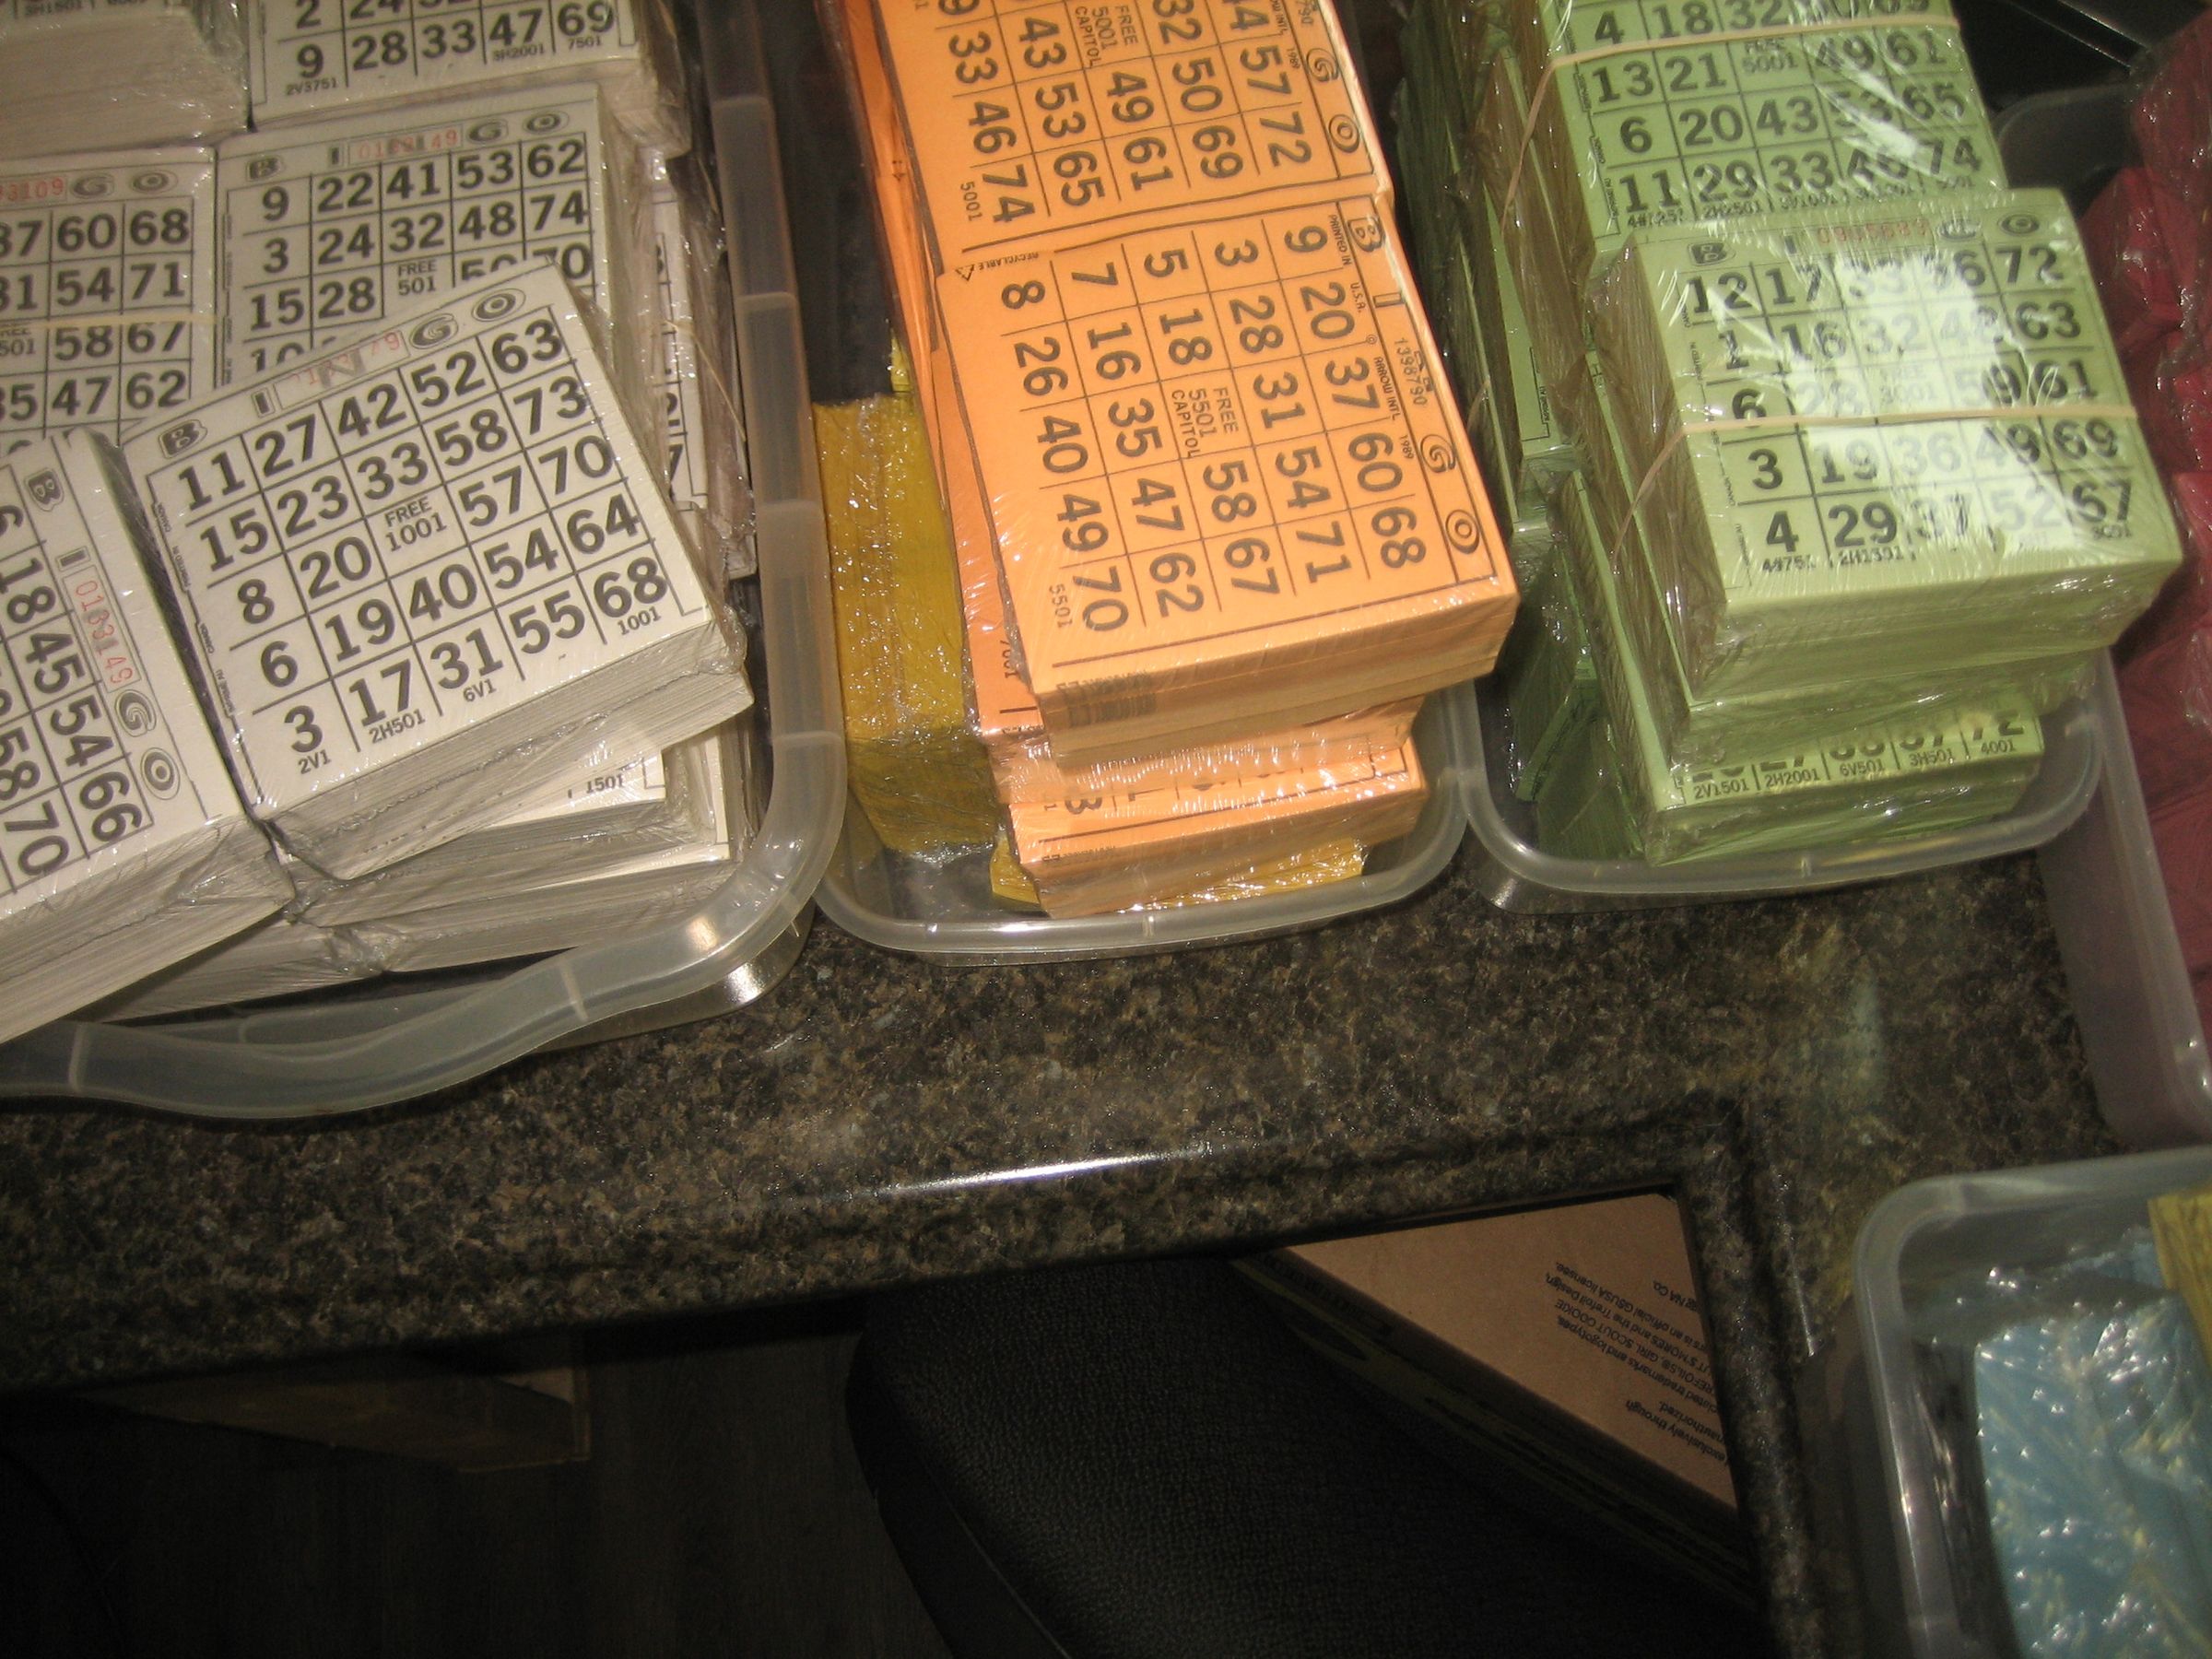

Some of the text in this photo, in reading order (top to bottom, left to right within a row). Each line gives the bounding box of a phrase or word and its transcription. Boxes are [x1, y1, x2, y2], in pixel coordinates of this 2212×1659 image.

[351, 8, 544, 71] 28 33 47
[568, 35, 601, 50] 7501
[1074, 6, 1102, 69] CAPITOL
[1092, 6, 1117, 51] 5001
[1115, 5, 1138, 46] FREE
[1287, 47, 1300, 70] 1989
[1593, 60, 1653, 104] 13
[1665, 53, 1726, 93] 21
[947, 31, 1036, 223] 33 46 74
[1018, 17, 1105, 206] 43 53 65
[1107, 71, 1174, 192] 49 61
[1171, 56, 1243, 179] 50 69
[1240, 44, 1312, 167] 57 72
[1679, 95, 1819, 147] 20 43
[262, 139, 585, 221] 9 22 41 53 62
[960, 182, 982, 221] 5001
[1619, 169, 1680, 213] 11
[1693, 159, 1758, 204] 29
[1769, 151, 1835, 194] 33
[56, 208, 190, 253] 60 68
[264, 190, 588, 273] 3 24 32 48 74
[56, 262, 185, 306] 54 71
[397, 260, 438, 275] FREE
[978, 252, 1040, 270] RECYCLABLE
[250, 277, 376, 331] 15 28
[397, 280, 437, 296] 501
[1688, 271, 1748, 314] 12
[1328, 214, 1347, 253] PRINTED
[1349, 282, 1362, 312] U.S.A.
[1373, 357, 1394, 395] ARROW
[1401, 435, 1414, 460] 1989
[2016, 301, 2082, 342] 63
[52, 370, 186, 415] 47 62
[1014, 336, 1068, 396] 26
[178, 452, 245, 511] 11
[254, 414, 316, 477] 27
[338, 383, 406, 437] 42
[411, 352, 486, 407] 52
[492, 320, 563, 373] 63
[1171, 390, 1201, 459] CAPITOL
[1189, 389, 1218, 439] 5501
[1214, 387, 1239, 434] FREE
[1300, 281, 1427, 569] 20 37 60 68
[1037, 415, 1088, 474] 40
[1159, 308, 1280, 594] 18 58 67
[1230, 295, 1352, 583] 28 31 54 71
[1747, 418, 2119, 490] 3 69
[200, 376, 588, 571] 15 23 33 58 73
[1087, 322, 1204, 618] 16 35 47 62
[238, 579, 275, 624] 8
[300, 537, 372, 599] 20
[458, 465, 522, 526] 57
[538, 435, 613, 494] 70
[384, 497, 431, 527] FREE
[385, 512, 446, 552] 1001
[1057, 494, 1109, 551] 49
[1766, 502, 1898, 553] 4 29
[261, 494, 641, 687] 6 19 40 54 64
[1049, 582, 1073, 629] 5501
[1073, 565, 1129, 631] 70
[284, 558, 667, 753] 3 17 31 55 68
[298, 606, 661, 773] 2V1 2H501 6V1 1001
[26, 632, 143, 842] 45 54 66
[1980, 739, 2017, 756] 4001
[586, 773, 625, 794] 1501
[4, 800, 70, 876] 70
[1580, 1293, 1611, 1321] Trefoil
[1600, 1287, 1634, 1314] GSUSA
[1613, 1312, 1630, 1327] the
[1636, 1308, 1669, 1332] official
[1556, 1299, 1659, 1363] GIRL SCOUT COOKIE
[1606, 1347, 1628, 1363] and
[1630, 1322, 1650, 1337] and
[1628, 1357, 1686, 1394] trademarks
[1626, 1400, 1668, 1430] through
